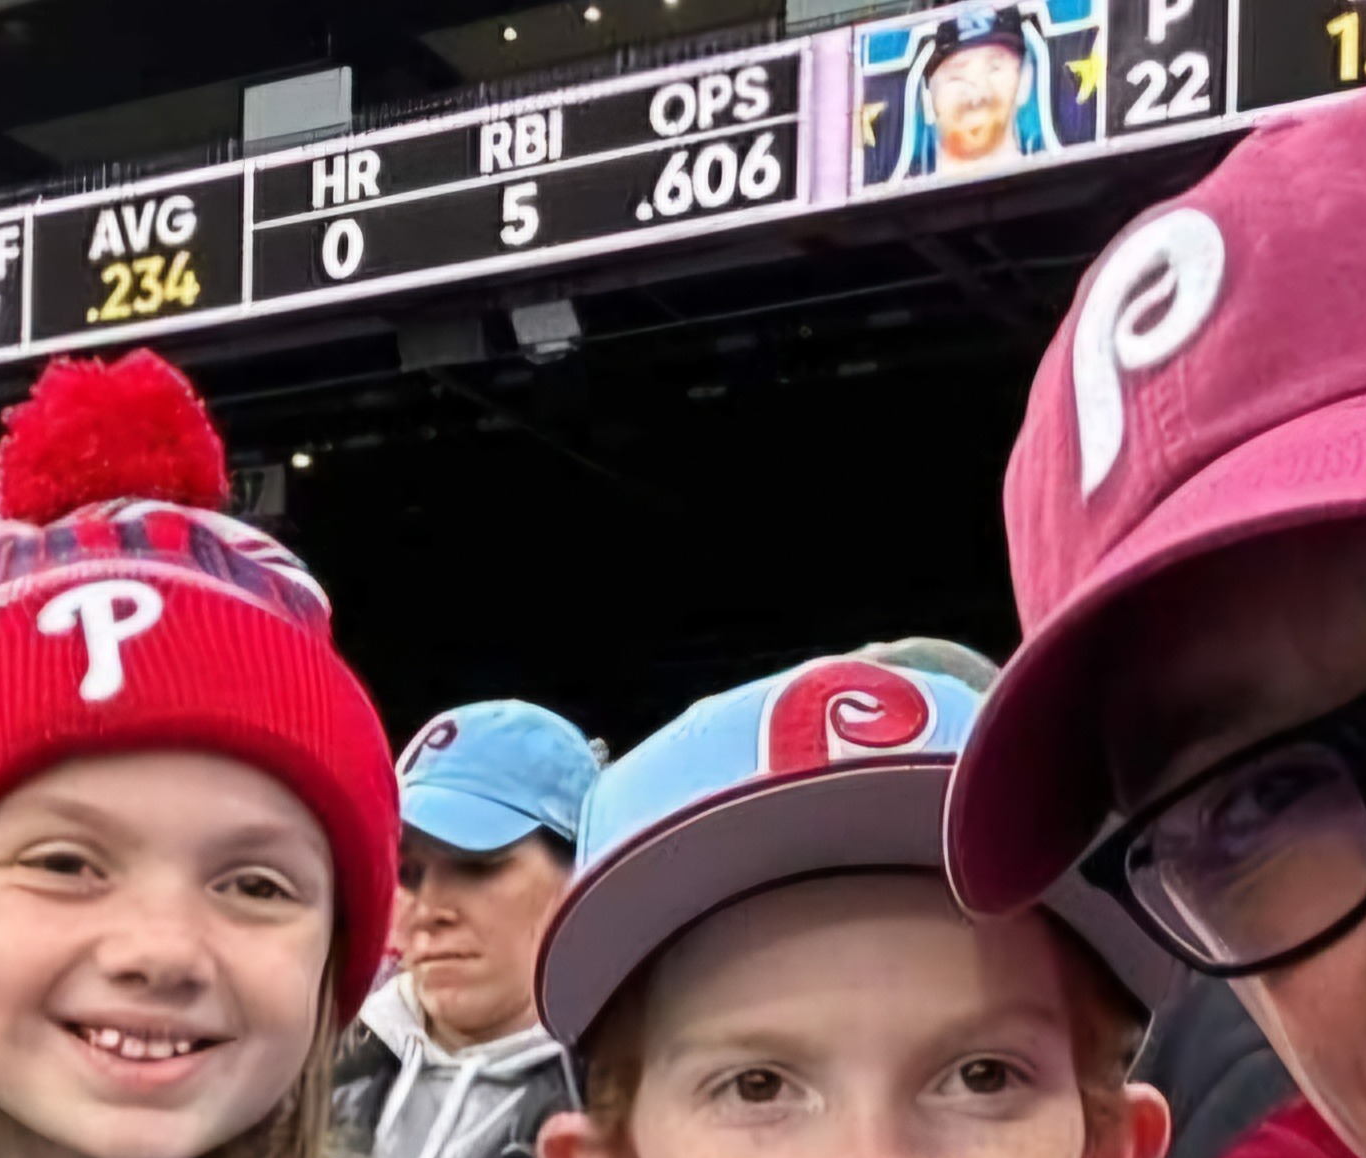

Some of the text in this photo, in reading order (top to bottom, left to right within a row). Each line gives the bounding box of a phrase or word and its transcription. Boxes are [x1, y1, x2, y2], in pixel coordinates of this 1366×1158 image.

[311, 65, 771, 210] HR RBI OPS
[1124, 51, 1211, 127] 22
[87, 194, 199, 262] AVG
[321, 131, 783, 281] 0 5 .606
[85, 250, 201, 324] .234
[36, 578, 164, 702] P
